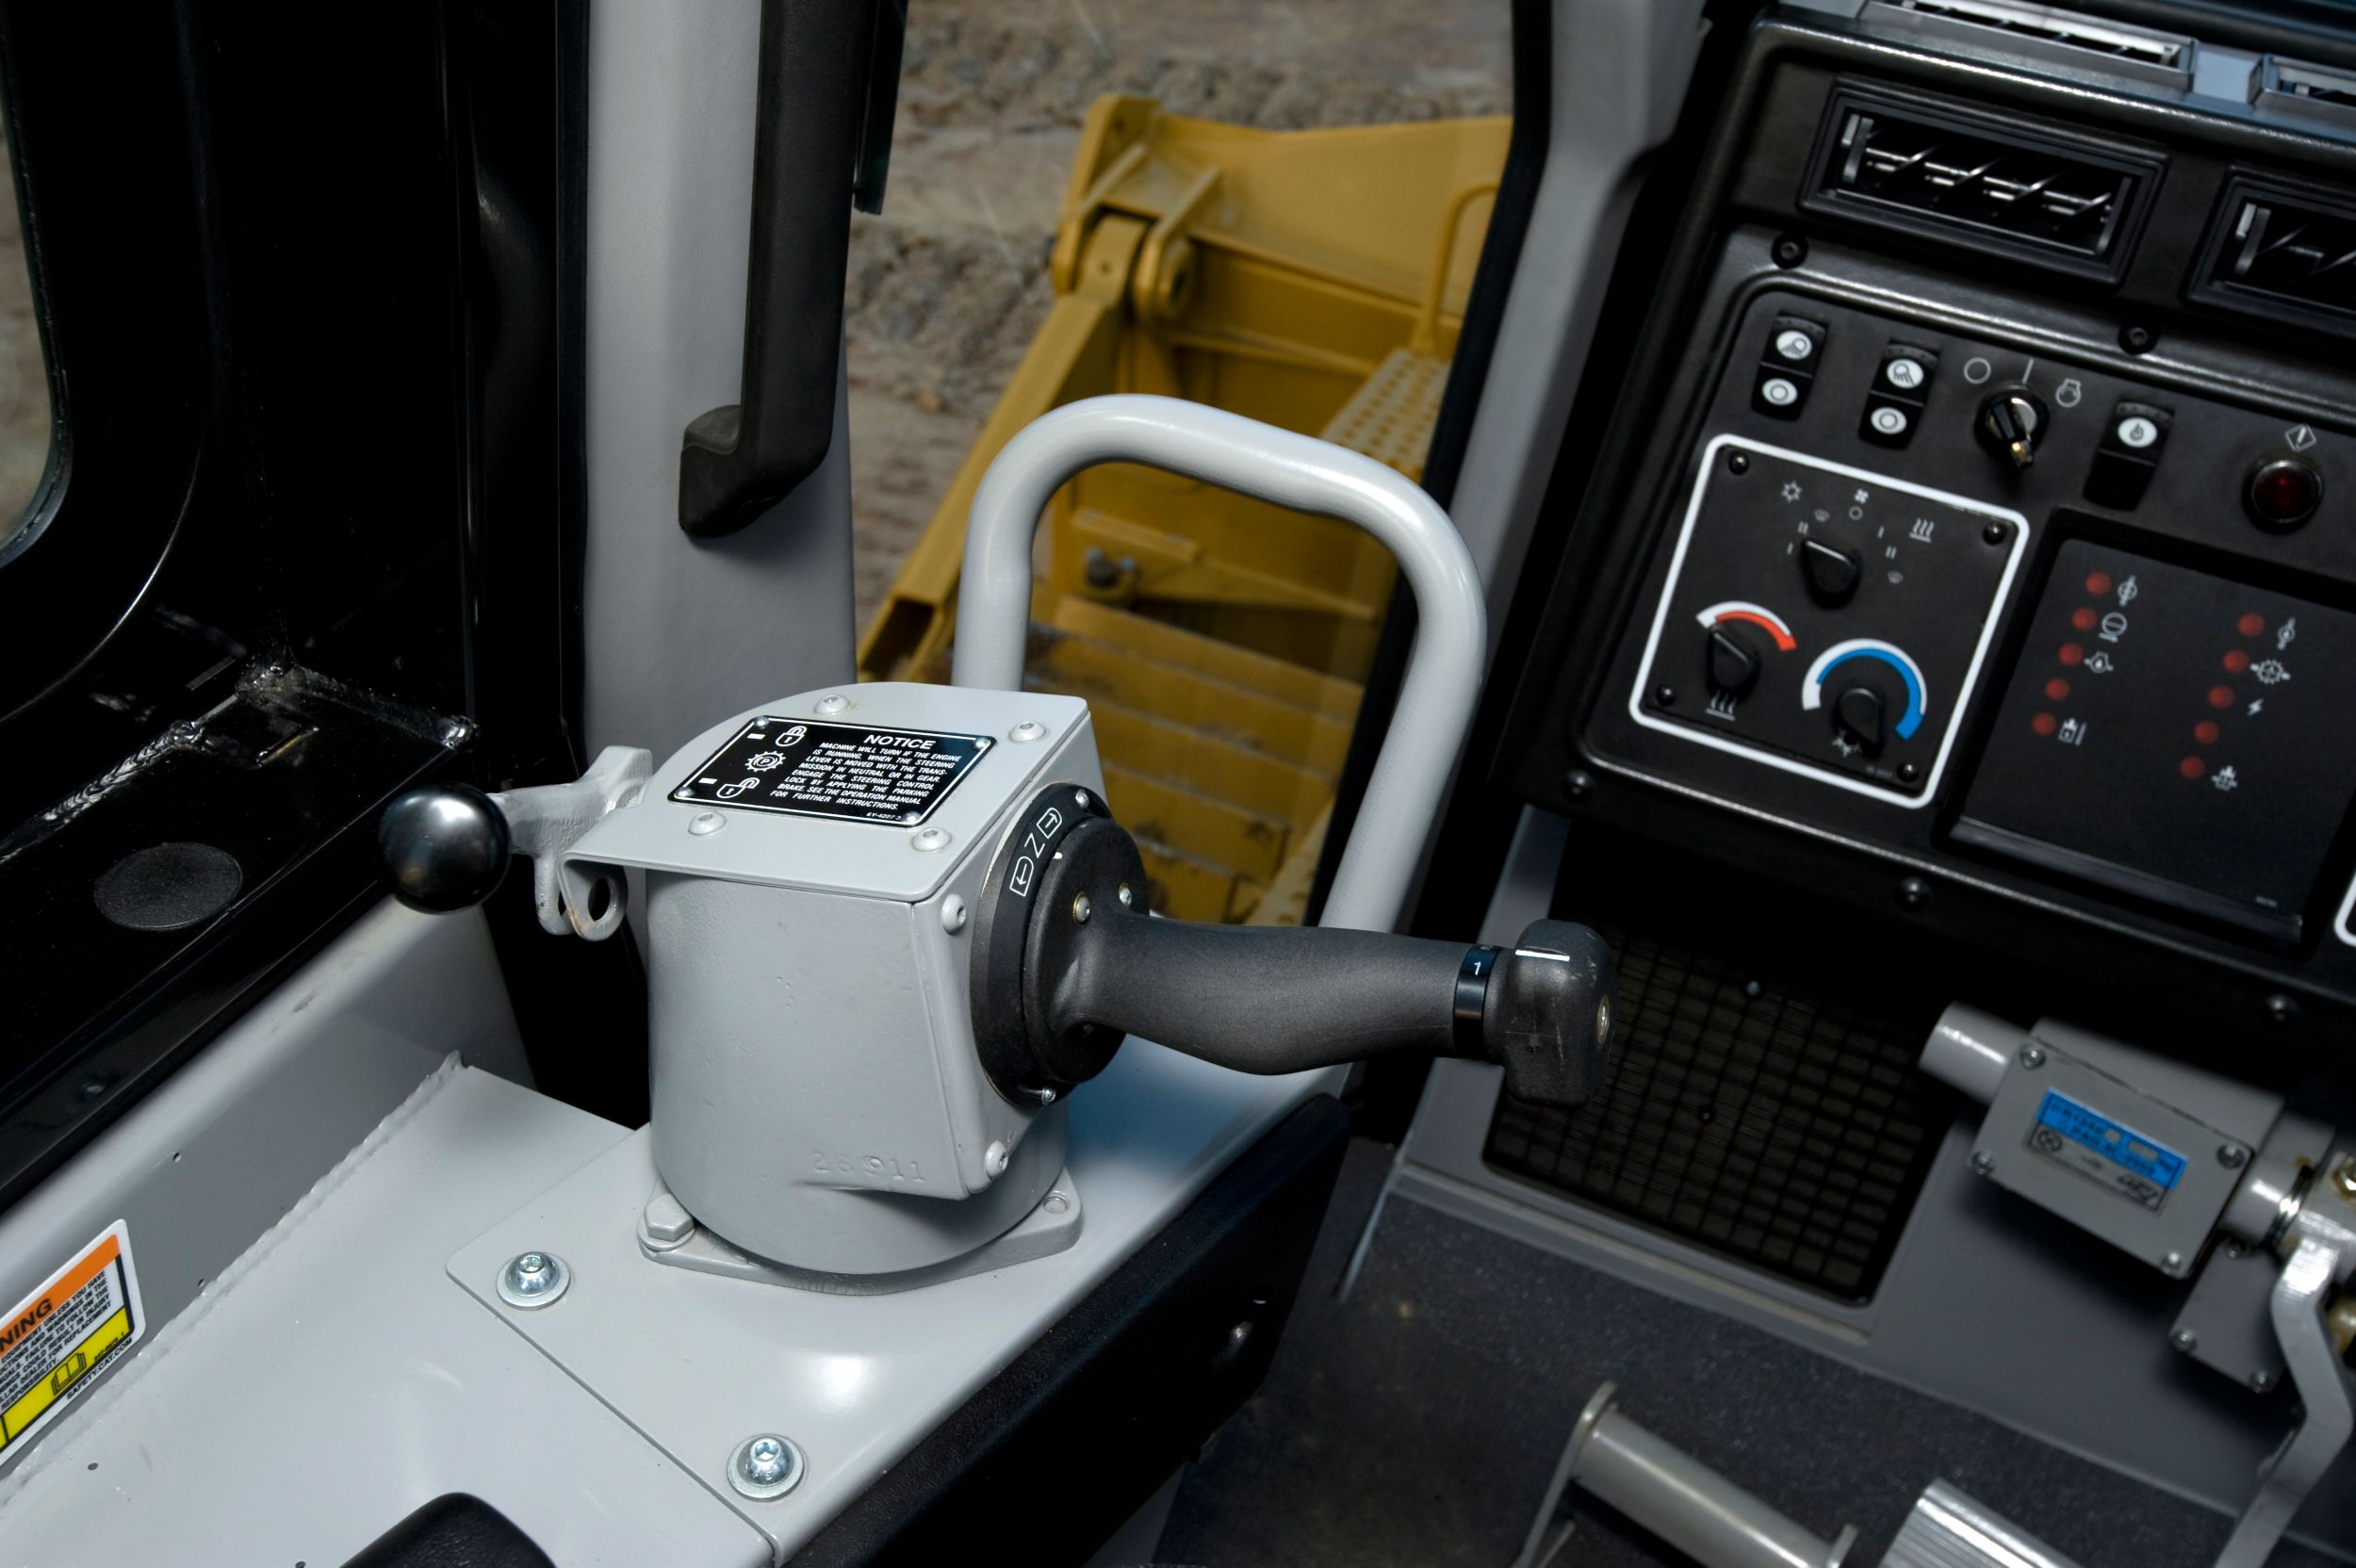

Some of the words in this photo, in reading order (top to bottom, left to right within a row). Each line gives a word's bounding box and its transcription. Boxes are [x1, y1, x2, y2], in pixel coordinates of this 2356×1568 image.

[863, 734, 937, 750] NOTICE
[819, 743, 857, 751] MACHINE
[930, 754, 962, 762] ENGINE
[798, 762, 834, 772] MISSION
[848, 768, 884, 776] NEUTRAL
[843, 760, 874, 768] MOVED
[918, 767, 947, 776] TRANS-
[914, 760, 956, 769] STEERING
[792, 769, 826, 778] ENGAGE
[851, 776, 892, 785] STEERING
[896, 780, 935, 790] CONTROL
[826, 781, 867, 791] APPLYING
[892, 788, 929, 797] PARKING
[793, 792, 832, 803] FURTHER
[836, 798, 899, 810] INSTRUCTIONS.
[841, 791, 887, 800] OPERATION
[887, 795, 922, 805] MANUAL
[66, 1336, 132, 1399] SAFETY.CAT.COM
